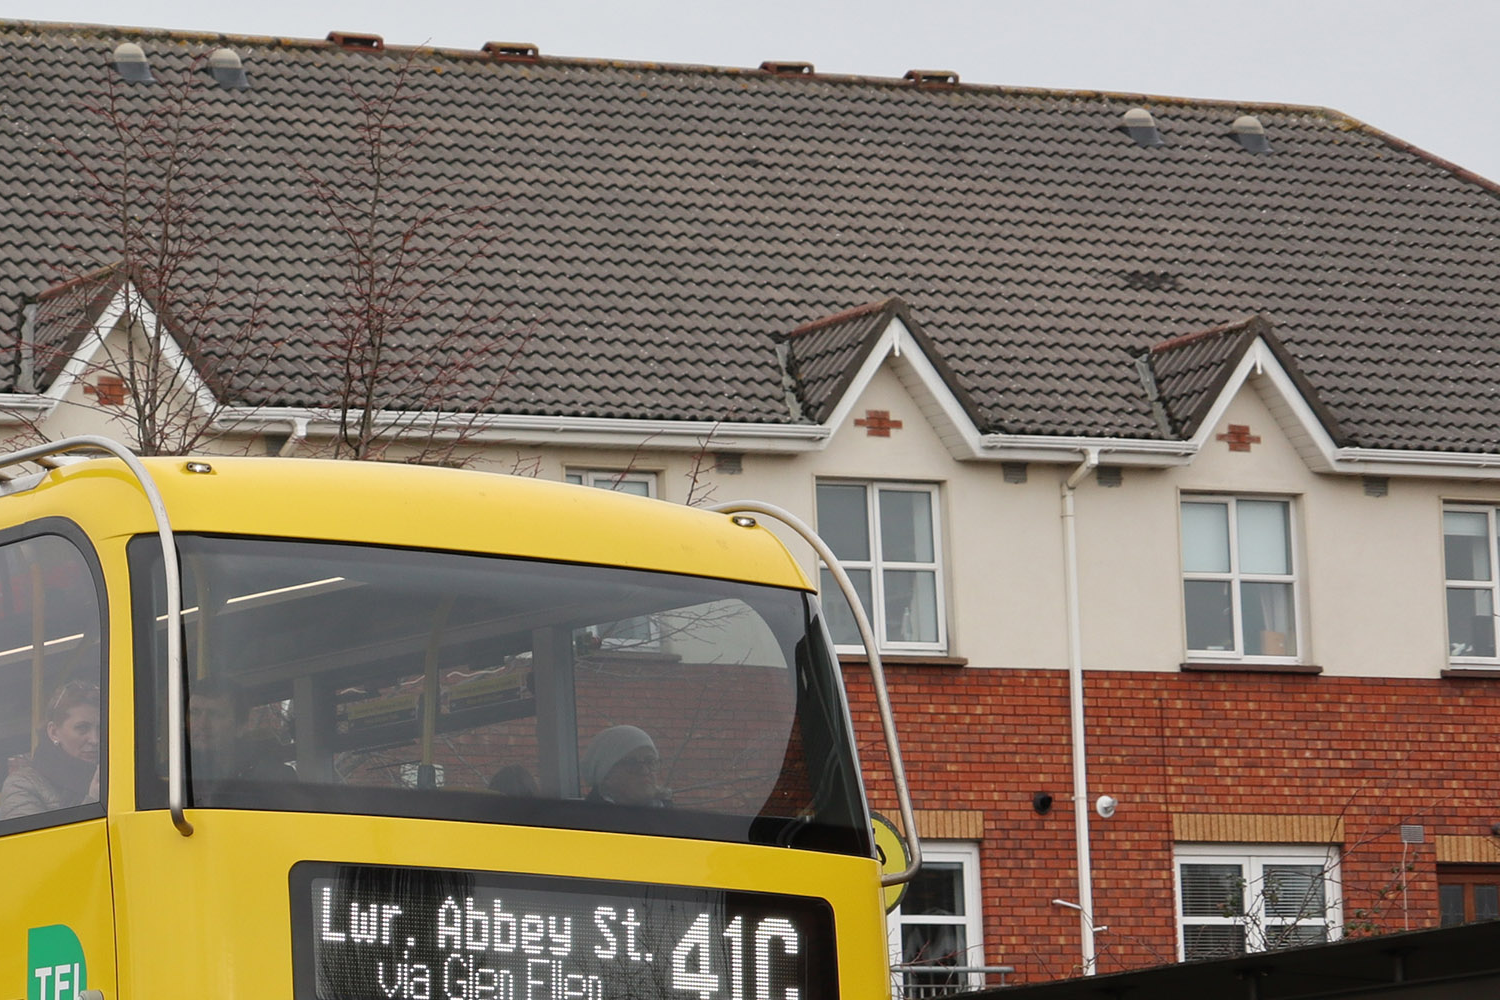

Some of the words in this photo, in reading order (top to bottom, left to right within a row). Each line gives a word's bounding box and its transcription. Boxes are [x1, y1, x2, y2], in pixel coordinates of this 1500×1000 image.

[320, 887, 417, 947] Lwr.
[437, 895, 572, 956] Abbey
[593, 905, 653, 962] St.
[377, 950, 430, 1000] via
